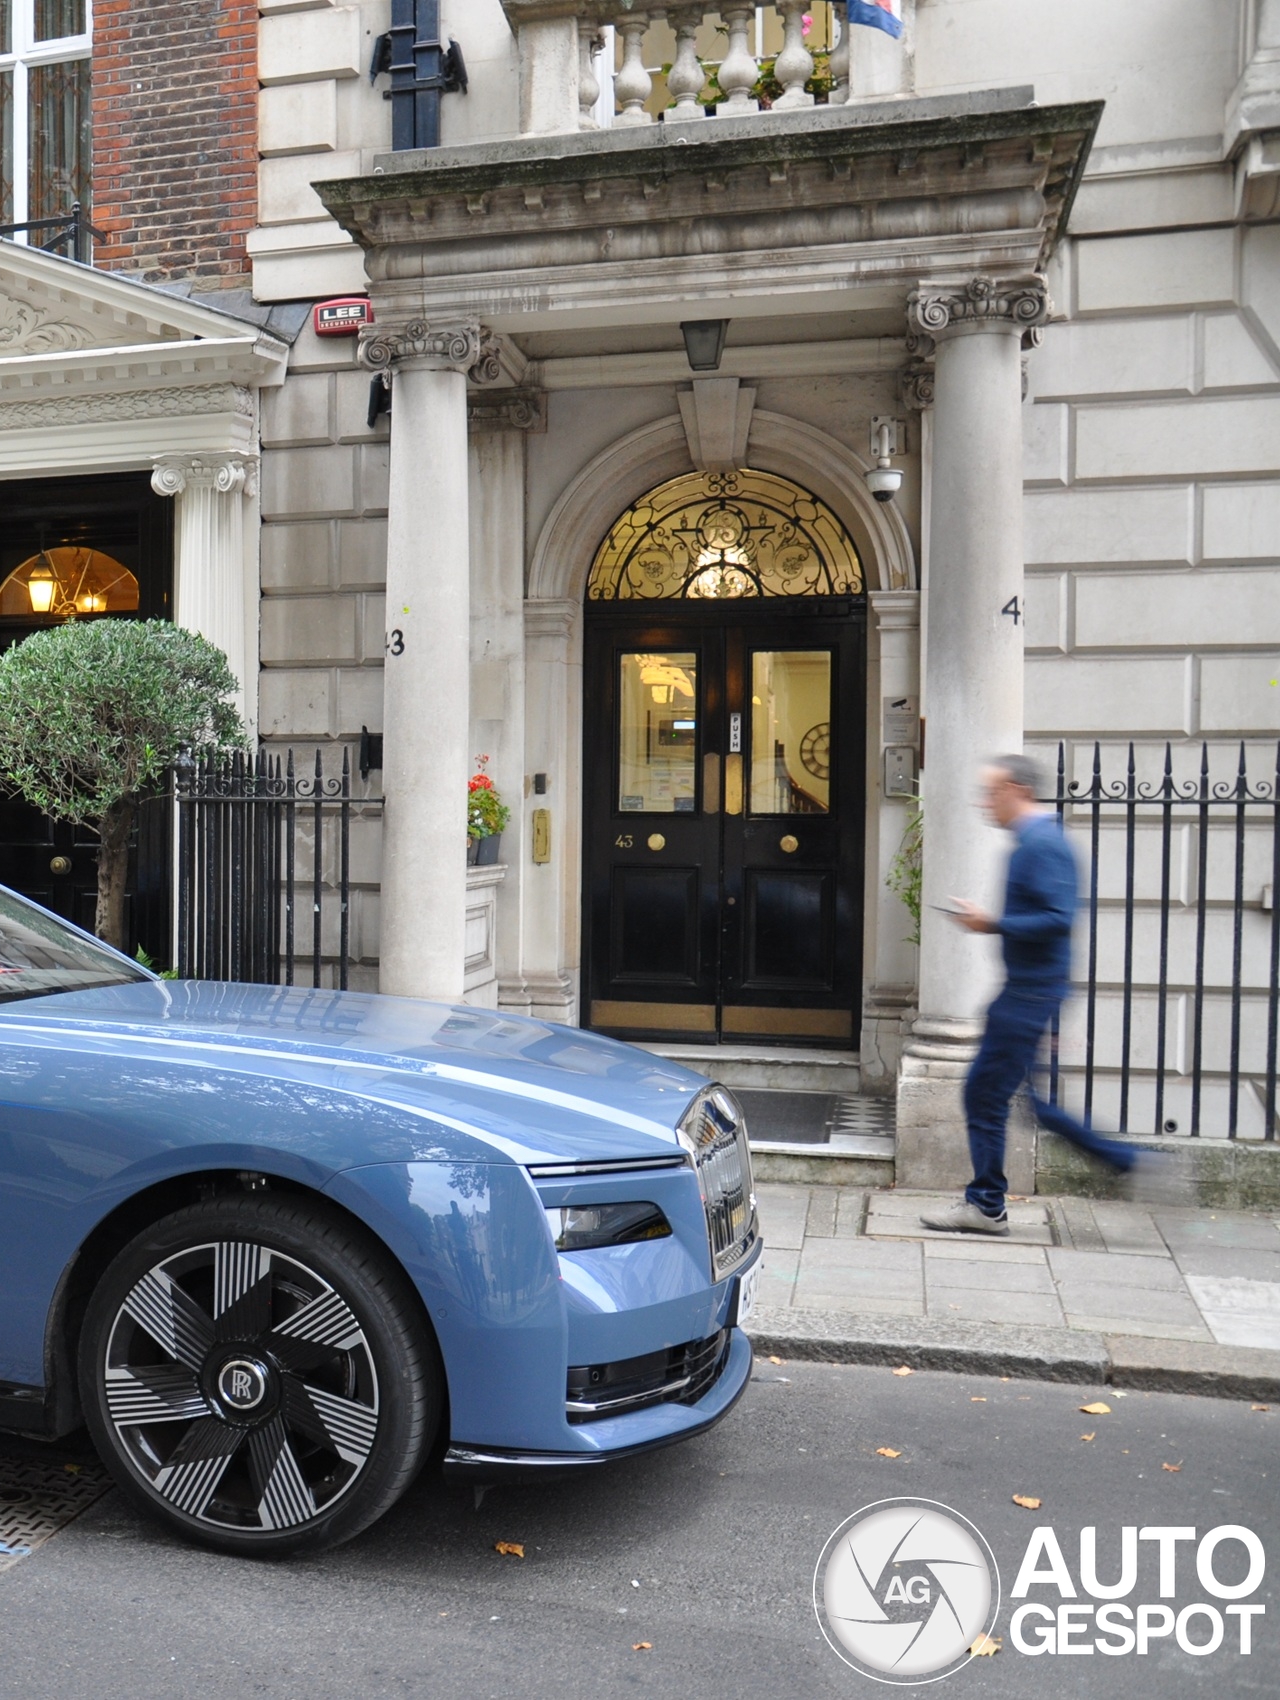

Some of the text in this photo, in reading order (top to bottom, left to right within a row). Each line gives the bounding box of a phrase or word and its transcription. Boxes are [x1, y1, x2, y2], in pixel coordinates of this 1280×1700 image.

[323, 306, 361, 320] LEE
[1001, 595, 1024, 626] 4
[384, 629, 405, 656] 3
[614, 834, 633, 848] 43
